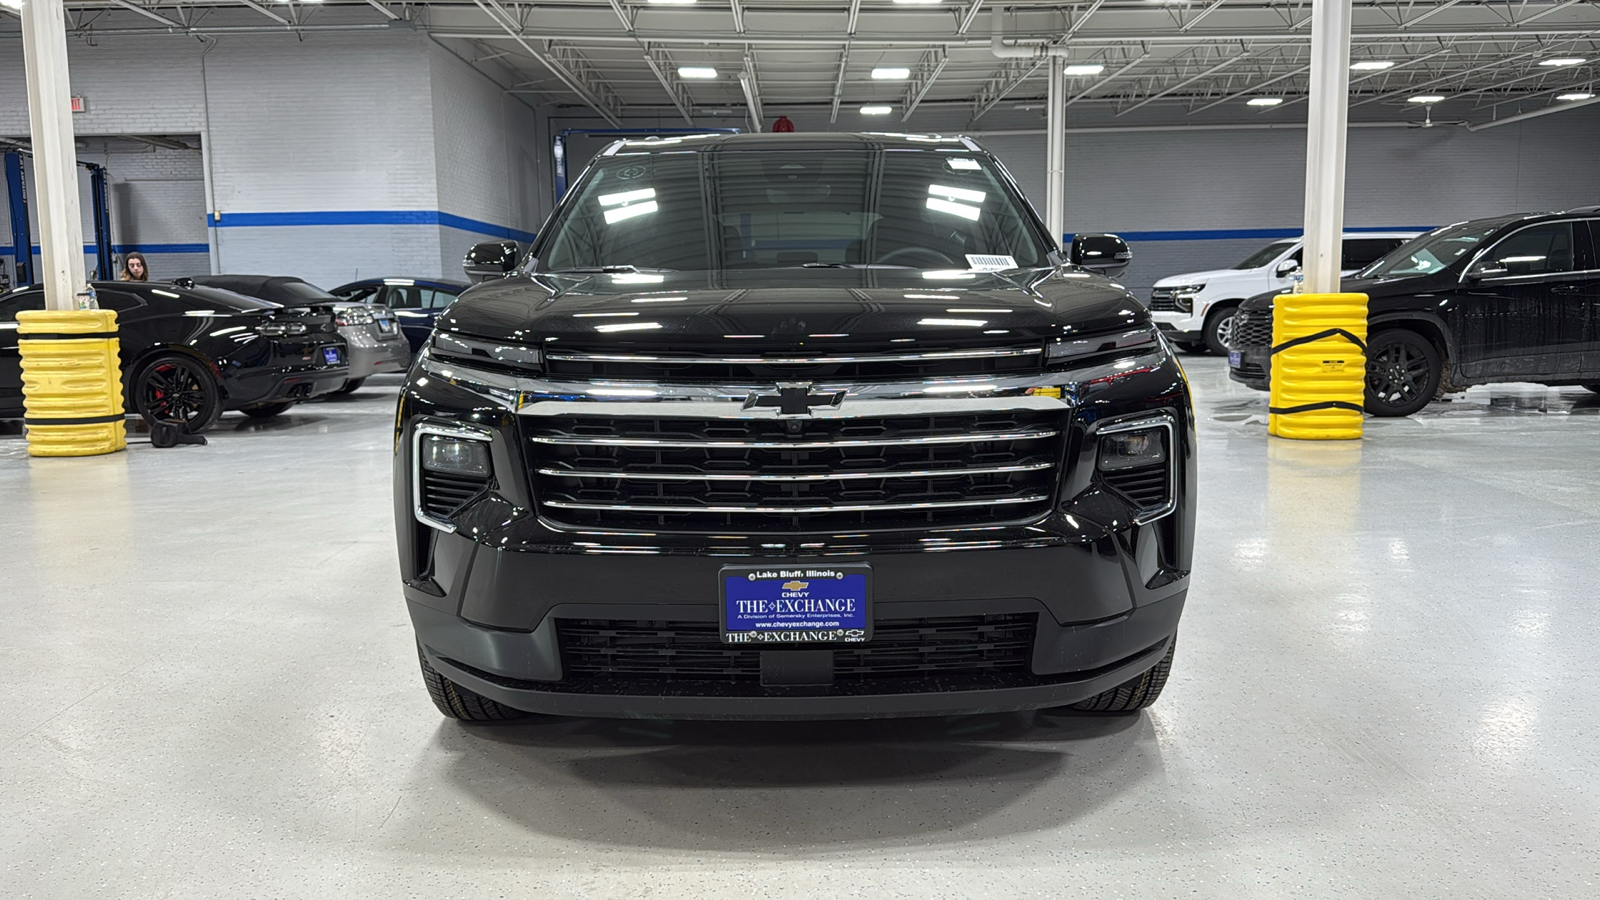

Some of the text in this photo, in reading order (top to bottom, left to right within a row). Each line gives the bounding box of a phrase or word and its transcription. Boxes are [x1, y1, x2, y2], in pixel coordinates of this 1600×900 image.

[736, 599, 855, 613] THE EXCHANGE
[726, 631, 837, 642] THE EXCHANGE
